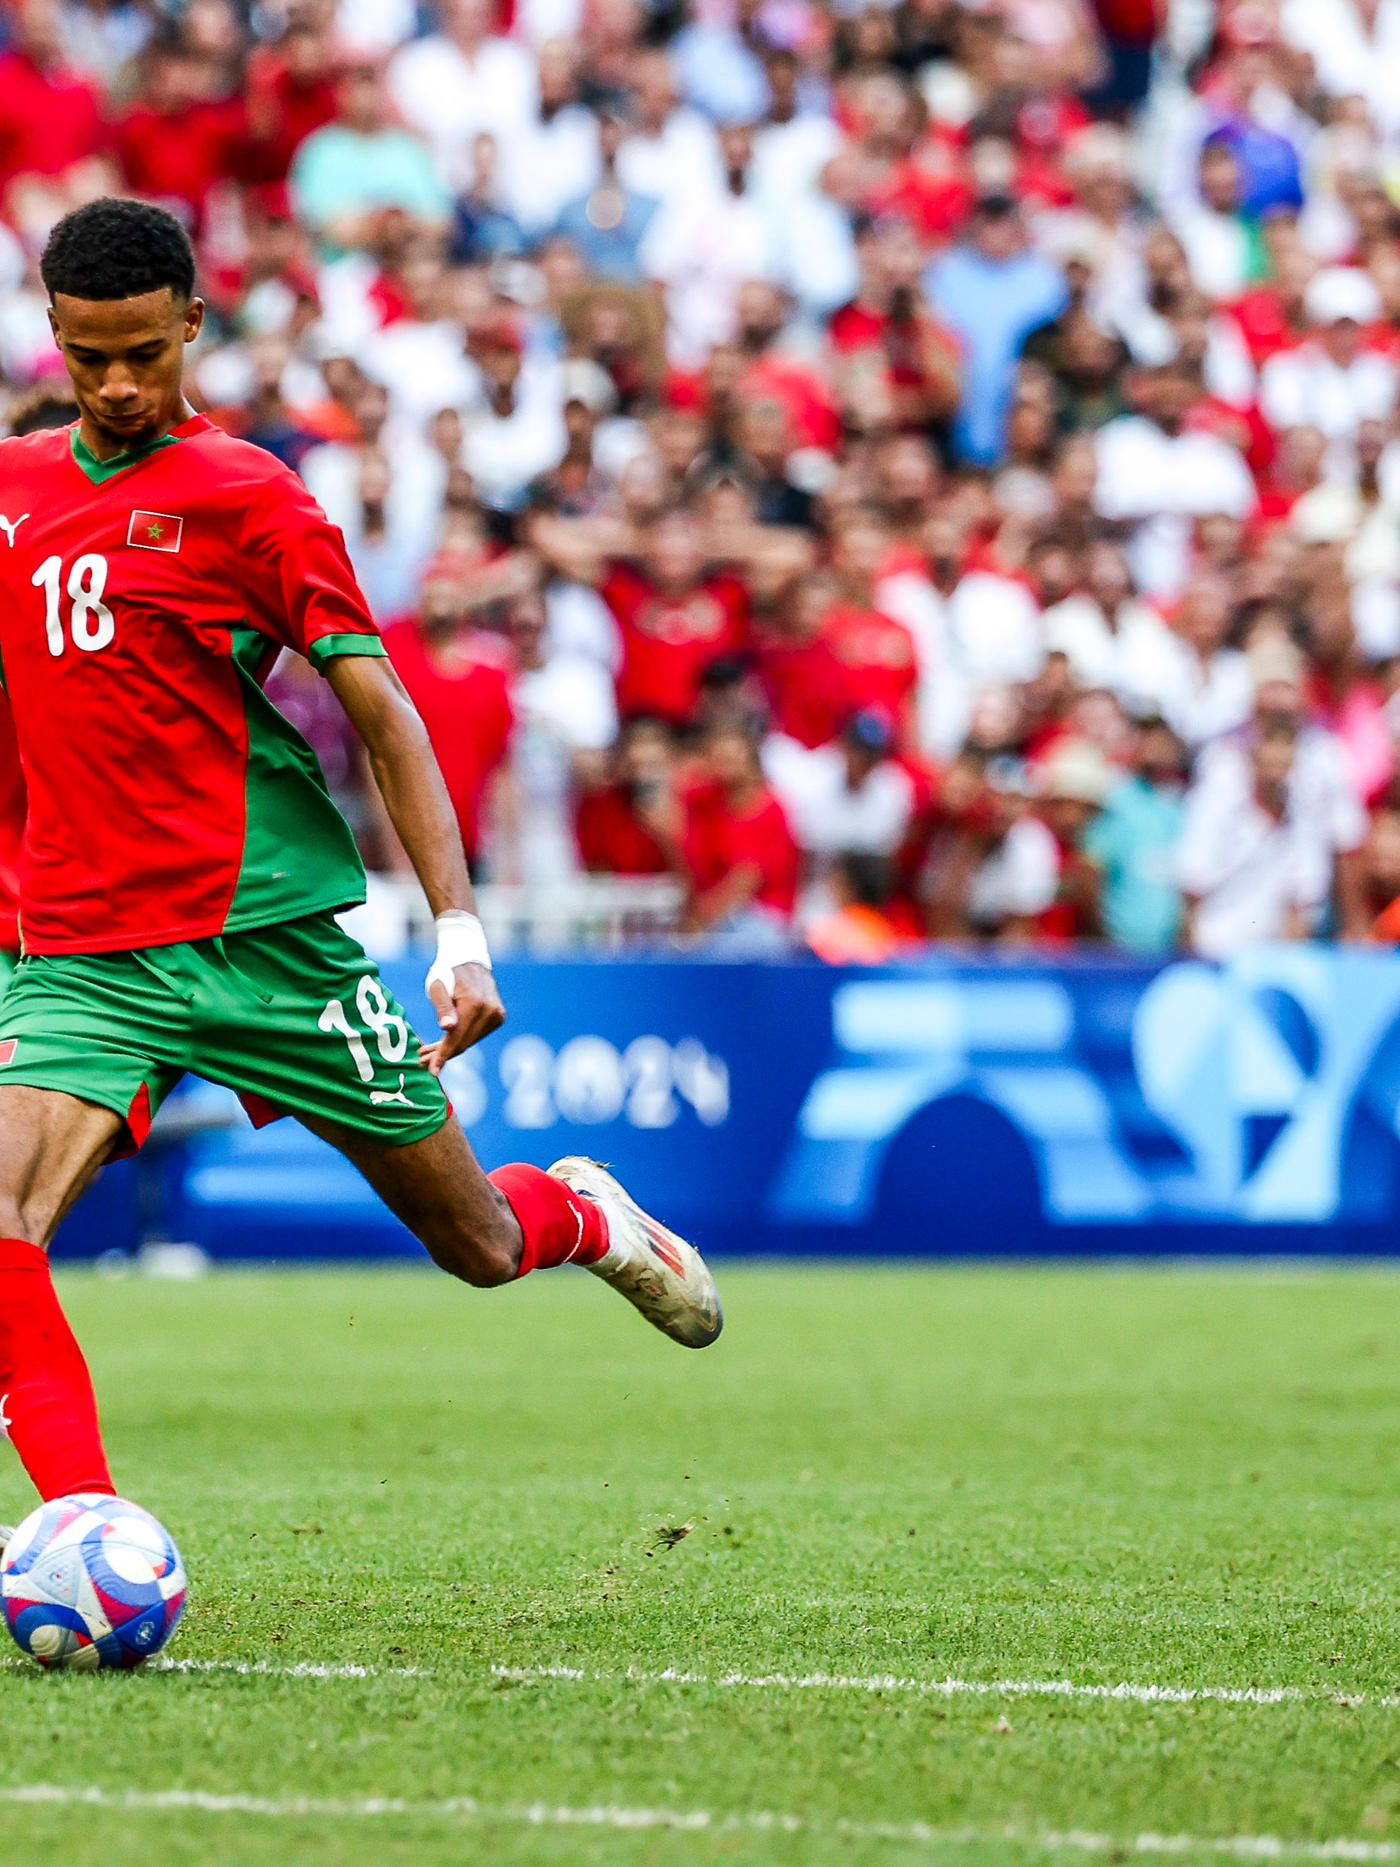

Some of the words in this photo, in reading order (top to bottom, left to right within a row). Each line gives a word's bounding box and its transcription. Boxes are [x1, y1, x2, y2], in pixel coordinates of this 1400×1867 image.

[31, 553, 115, 656] 18
[318, 975, 408, 1082] 18
[500, 1034, 730, 1129] 2024
